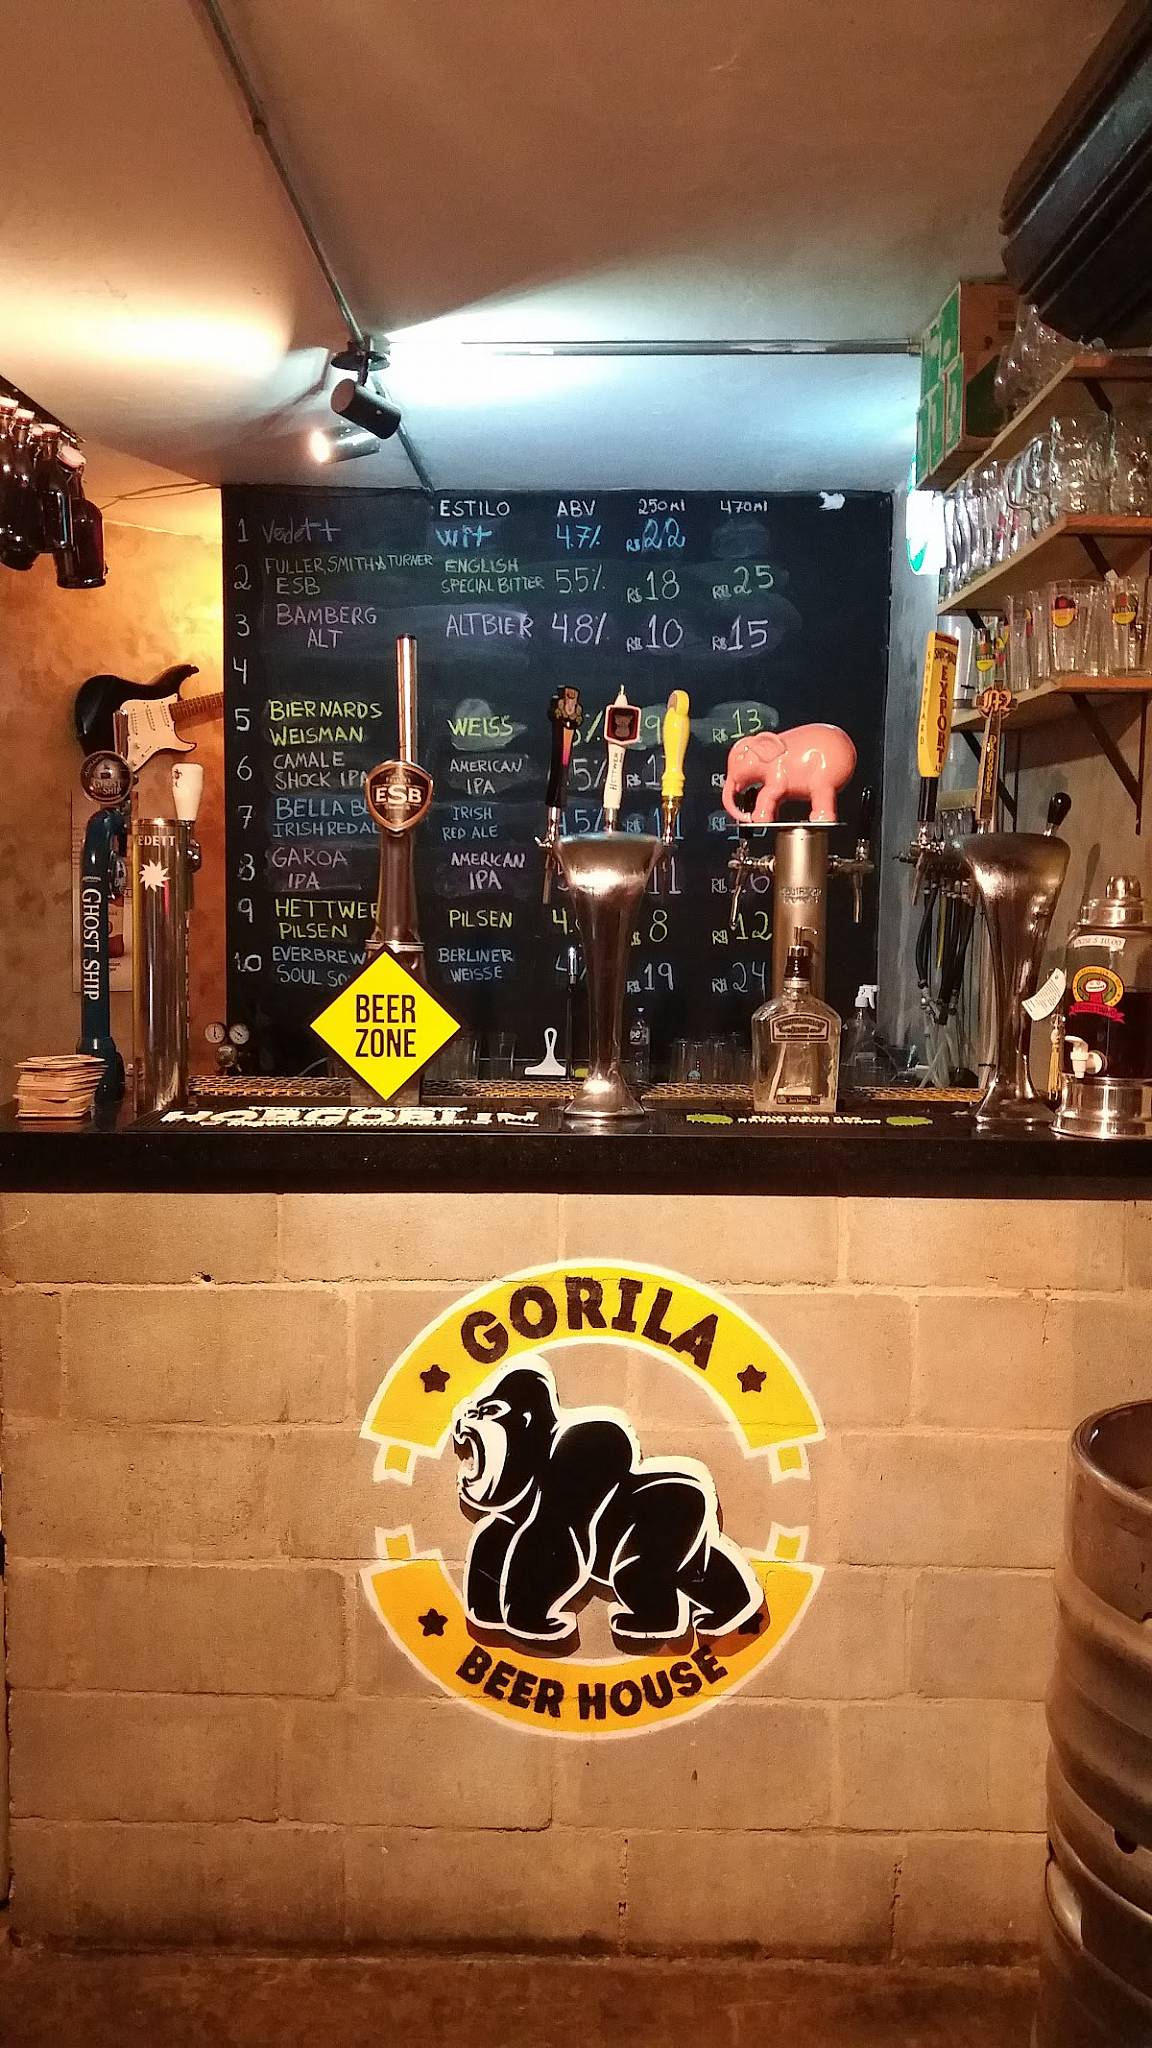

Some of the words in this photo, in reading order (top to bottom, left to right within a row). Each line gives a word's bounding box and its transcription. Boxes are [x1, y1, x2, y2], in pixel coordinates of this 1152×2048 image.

[440, 500, 510, 517] ESTILO
[557, 500, 596, 517] ABV
[237, 518, 249, 543] 1
[445, 557, 519, 574] ENGLISH
[233, 563, 252, 591] 2
[276, 576, 321, 596] ESB
[441, 578, 495, 594] SPECIAL
[498, 576, 545, 593] BITTER
[235, 613, 250, 637] 3
[276, 603, 377, 626] BAMBERG
[445, 612, 534, 640] ALTBIER
[307, 628, 344, 649] ALT
[233, 657, 248, 685] 4
[234, 708, 250, 732] 5
[936, 665, 949, 764] EXPORT
[269, 726, 364, 747] WEISMAN
[446, 714, 514, 738] WEISS
[237, 755, 253, 781] 6
[449, 757, 523, 773] AMERICAN
[275, 771, 331, 791] SHOCK
[466, 778, 496, 795] IPA
[375, 785, 422, 804] ESB
[237, 805, 254, 830] 7
[275, 796, 345, 821] BELLA
[451, 805, 493, 821] IRISH
[272, 822, 325, 838] IRISH
[327, 821, 358, 836] RED
[442, 827, 466, 841] RED
[471, 825, 498, 840] ALE
[271, 846, 349, 868] GAROA
[451, 852, 526, 869] AMERICAN
[288, 871, 320, 890] IPA
[469, 869, 503, 891] IPA
[82, 888, 101, 953] GHOST
[237, 898, 253, 923] 9
[449, 909, 513, 929] PILSEN
[279, 922, 349, 940] PILSEN
[234, 951, 262, 973] 10
[272, 946, 367, 966] EVERBREW
[437, 947, 514, 964] BERLINER
[83, 959, 100, 1000] SHIP
[276, 965, 323, 986] SOUL
[449, 965, 503, 983] WEISSE
[356, 994, 416, 1023] BEER
[355, 1029, 416, 1057] ZONE
[460, 1276, 719, 1370] GORILA
[456, 1645, 565, 1718] BEER
[578, 1643, 729, 1720] HOUSE
